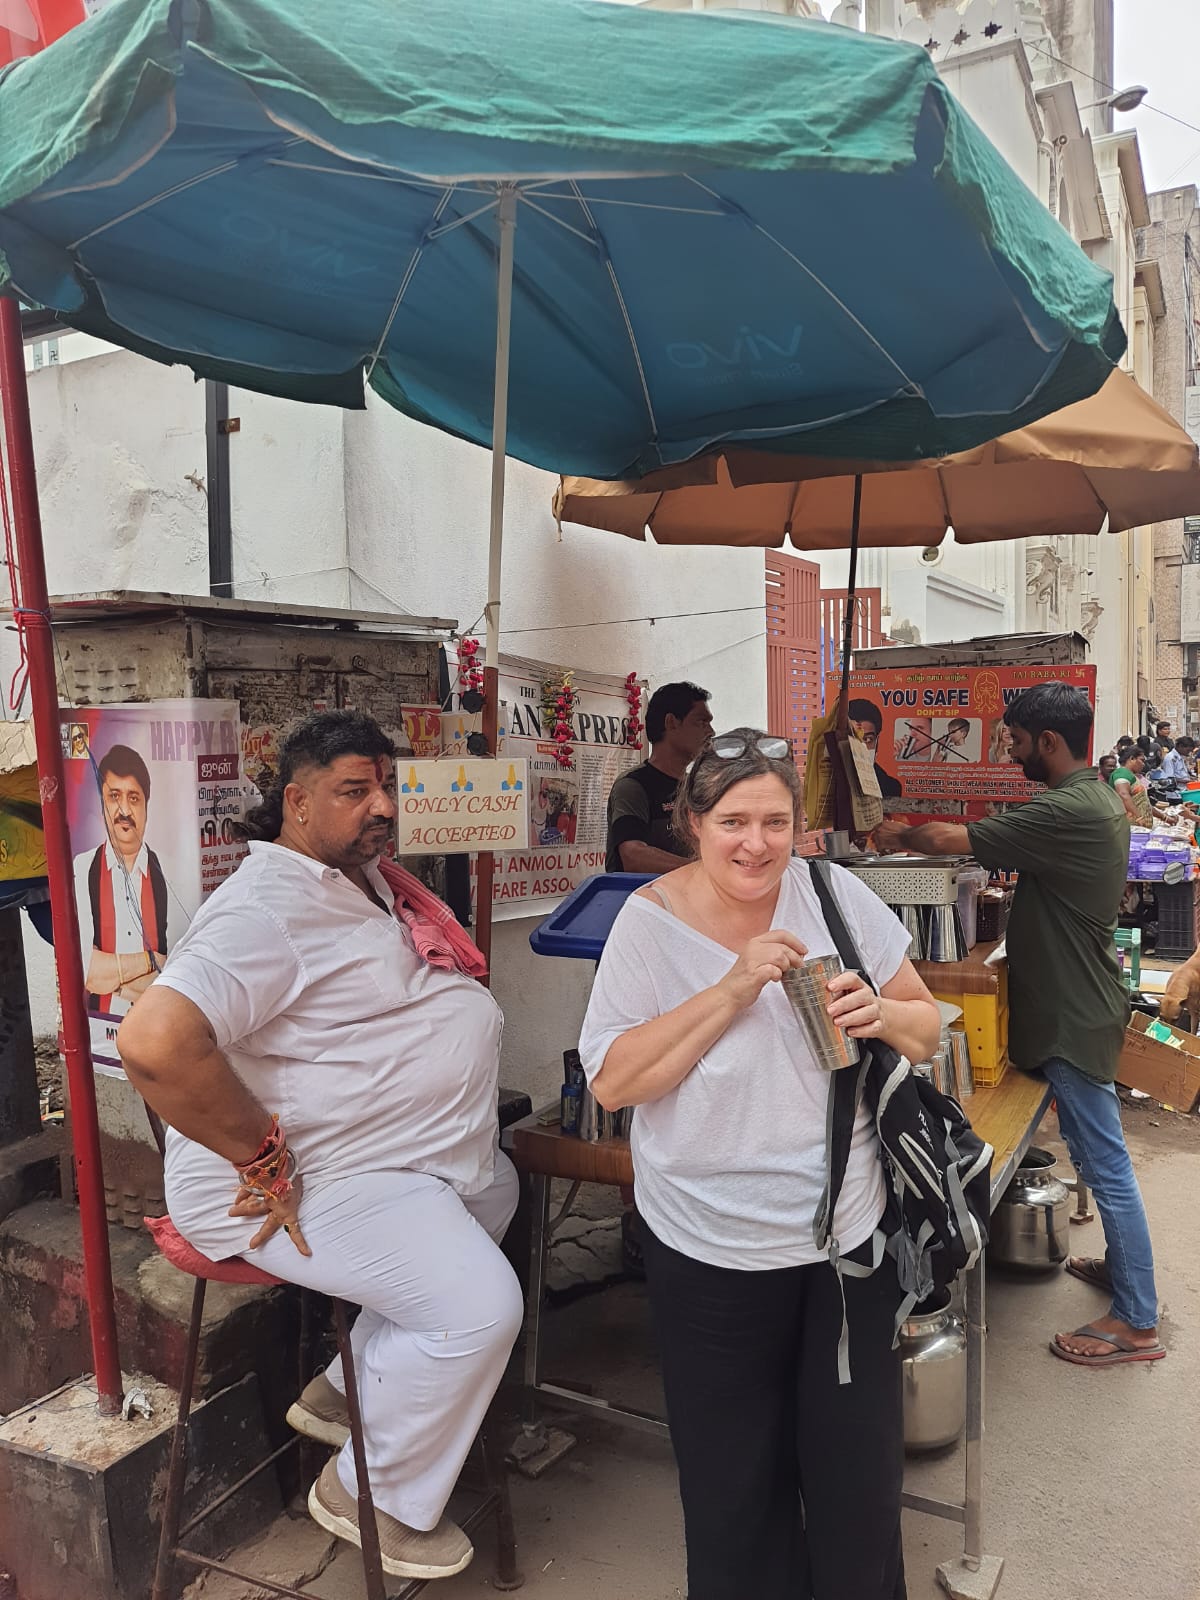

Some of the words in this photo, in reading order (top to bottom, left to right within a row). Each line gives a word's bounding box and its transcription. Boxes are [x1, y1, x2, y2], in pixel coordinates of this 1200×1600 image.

[520, 686, 537, 699] THE
[880, 688, 918, 707] YOU
[923, 688, 970, 706] SAFE
[916, 708, 942, 716] DON'T
[945, 708, 960, 716] SIP
[150, 720, 214, 760] HAPPY
[404, 795, 467, 814] ONLY
[467, 794, 523, 813] CASH
[405, 824, 516, 846] ACCEPTED
[508, 855, 564, 873] ANMOL
